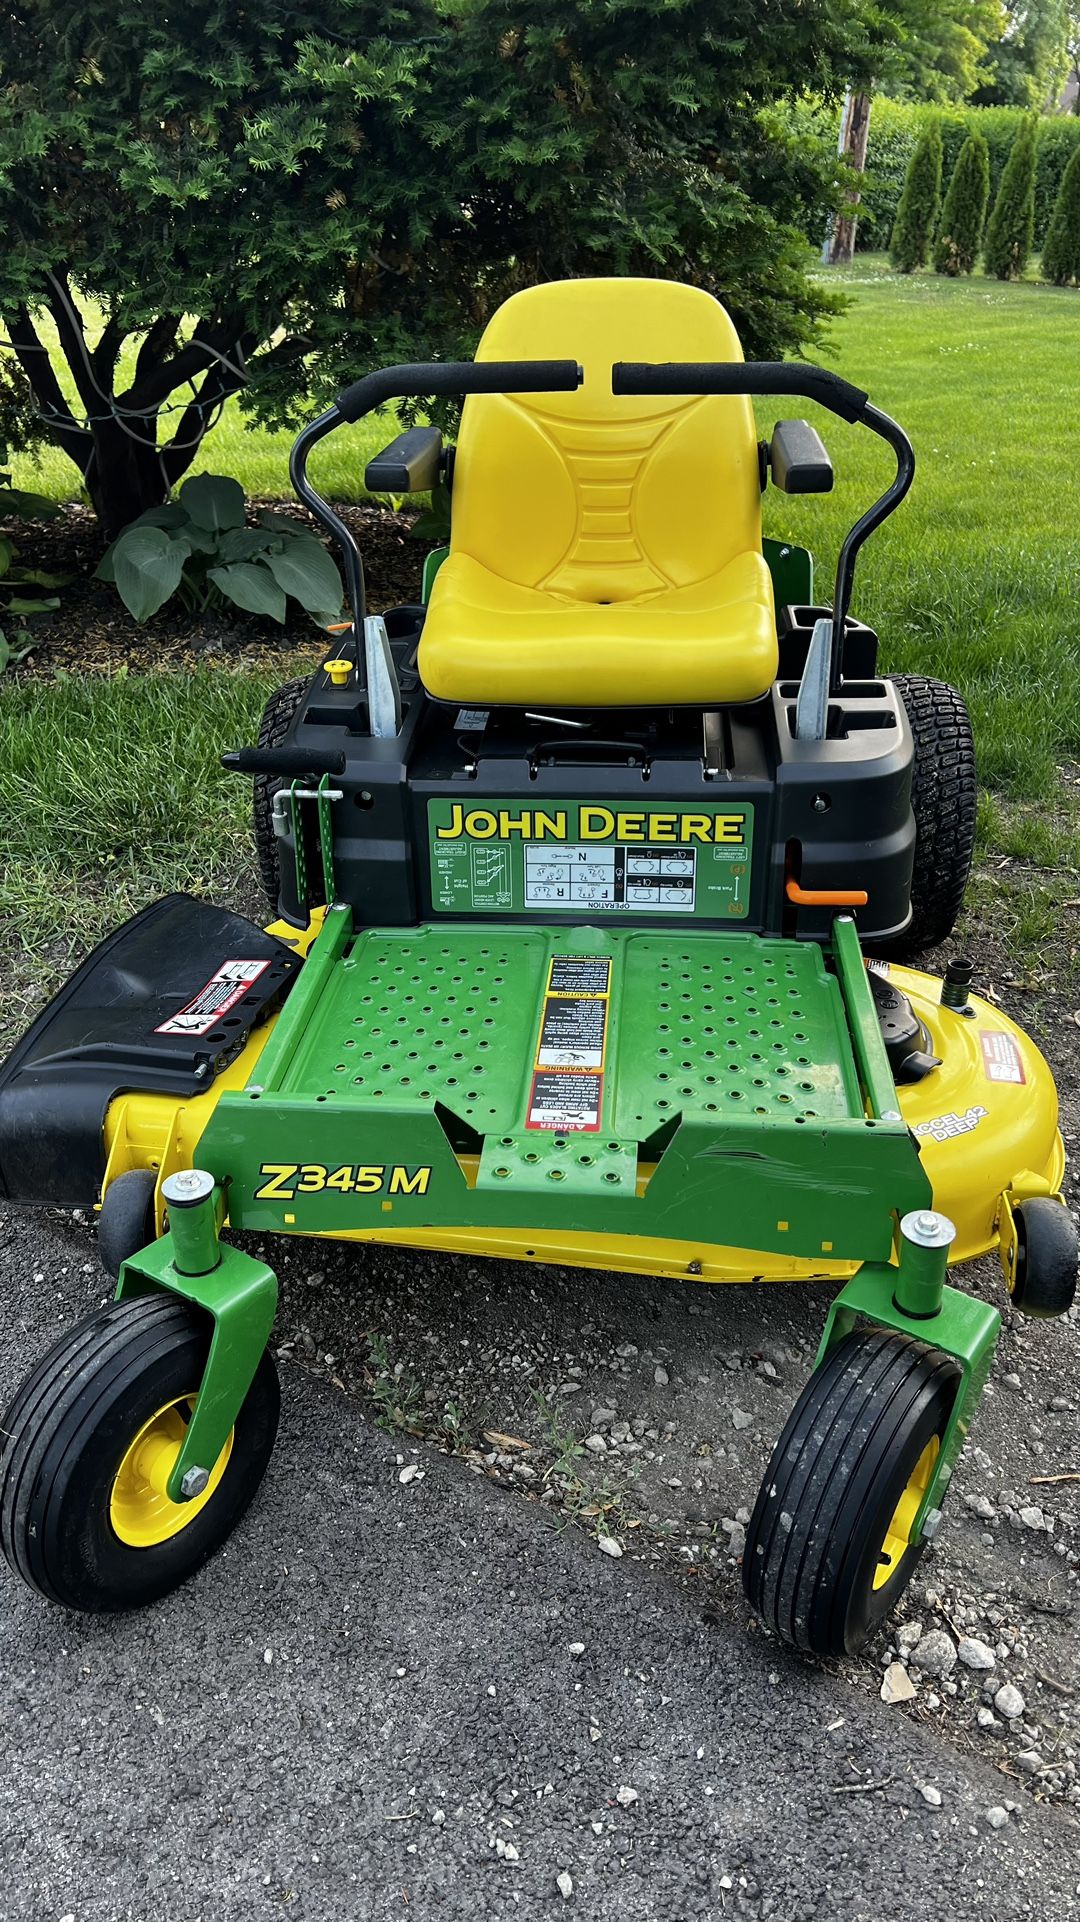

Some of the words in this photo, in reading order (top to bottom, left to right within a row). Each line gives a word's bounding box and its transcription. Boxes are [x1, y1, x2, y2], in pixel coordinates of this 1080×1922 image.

[436, 803, 568, 840] JOHN
[578, 805, 745, 843] DEERE
[579, 853, 586, 861] N
[931, 1117, 979, 1142] DEEP
